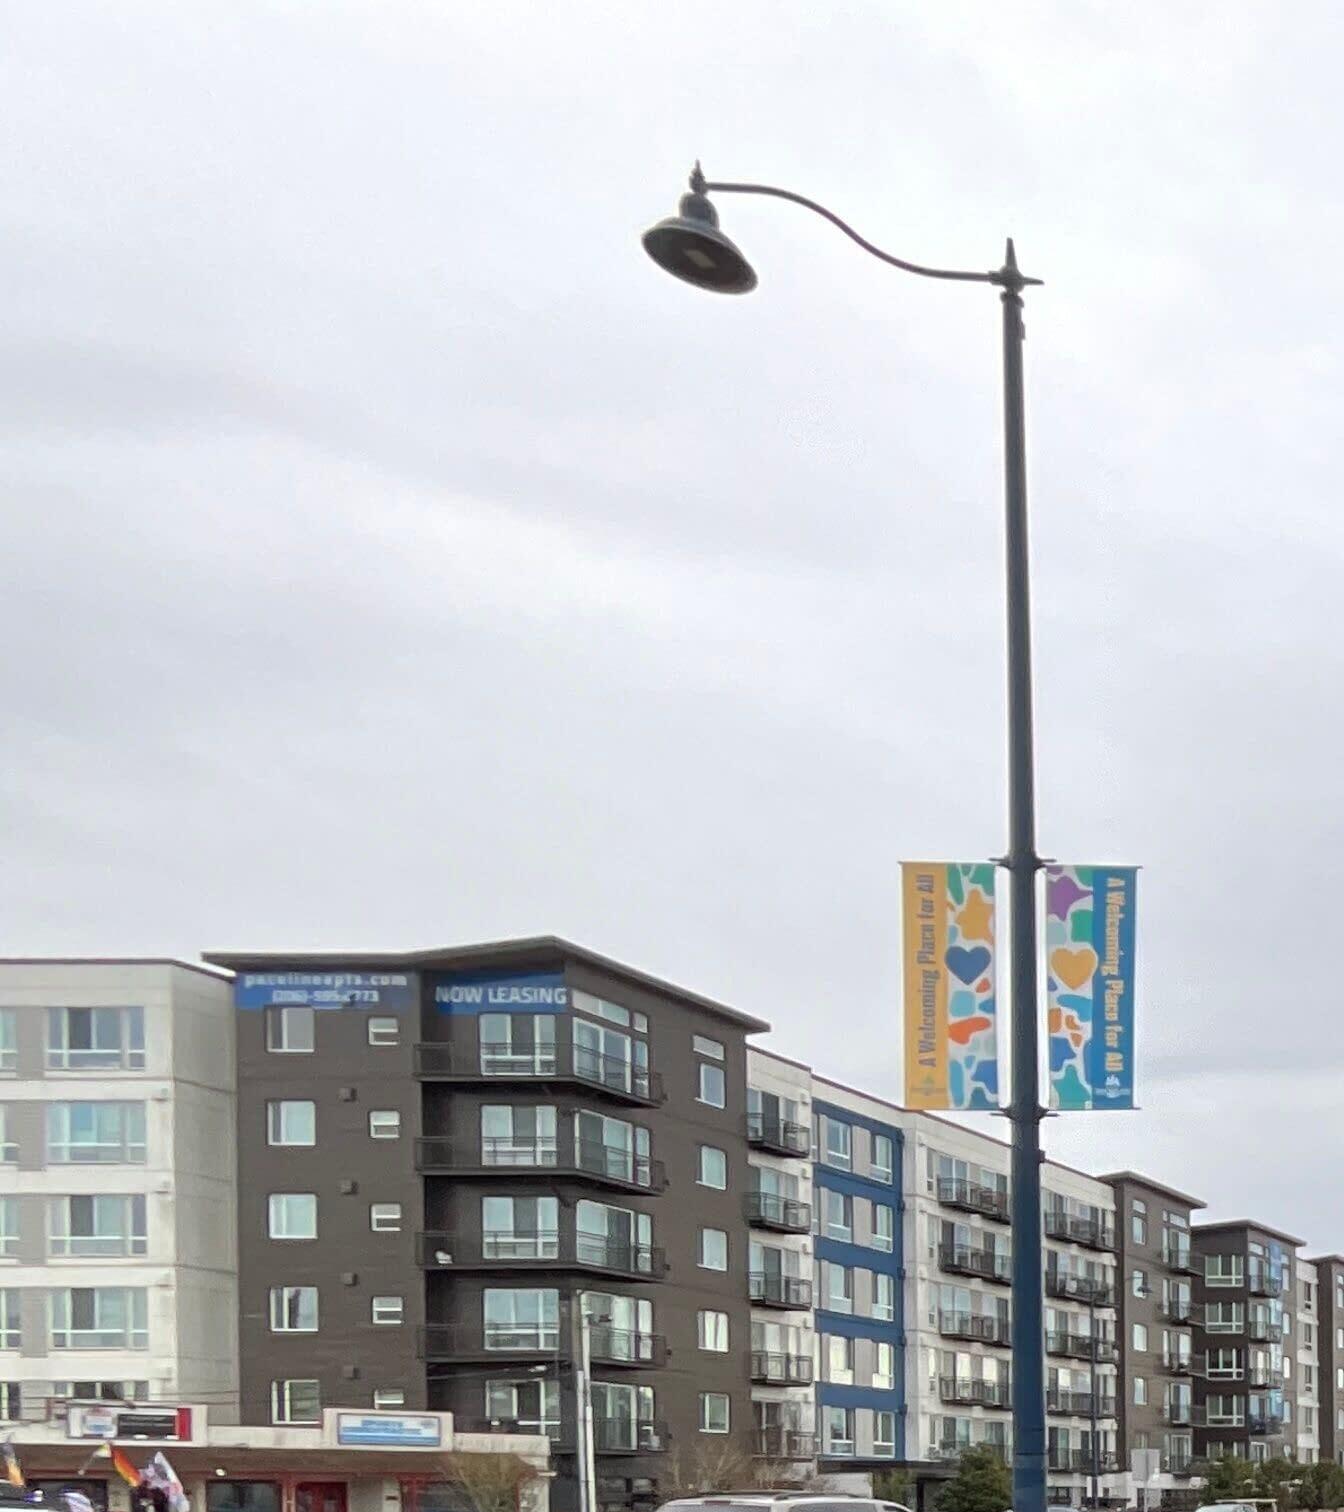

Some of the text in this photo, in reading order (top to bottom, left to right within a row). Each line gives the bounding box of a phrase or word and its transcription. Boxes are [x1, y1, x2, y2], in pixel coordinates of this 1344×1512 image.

[916, 874, 935, 893] All
[1107, 877, 1125, 887] A
[917, 898, 935, 918] for
[1101, 891, 1125, 976] Welcoming
[916, 923, 935, 965] Place
[434, 986, 568, 1004] NOW LEASING
[1105, 979, 1124, 1021] Place
[918, 970, 940, 1054] Welcoming
[1105, 1025, 1124, 1048] for
[919, 1058, 936, 1068] A
[1105, 1052, 1124, 1071] All
